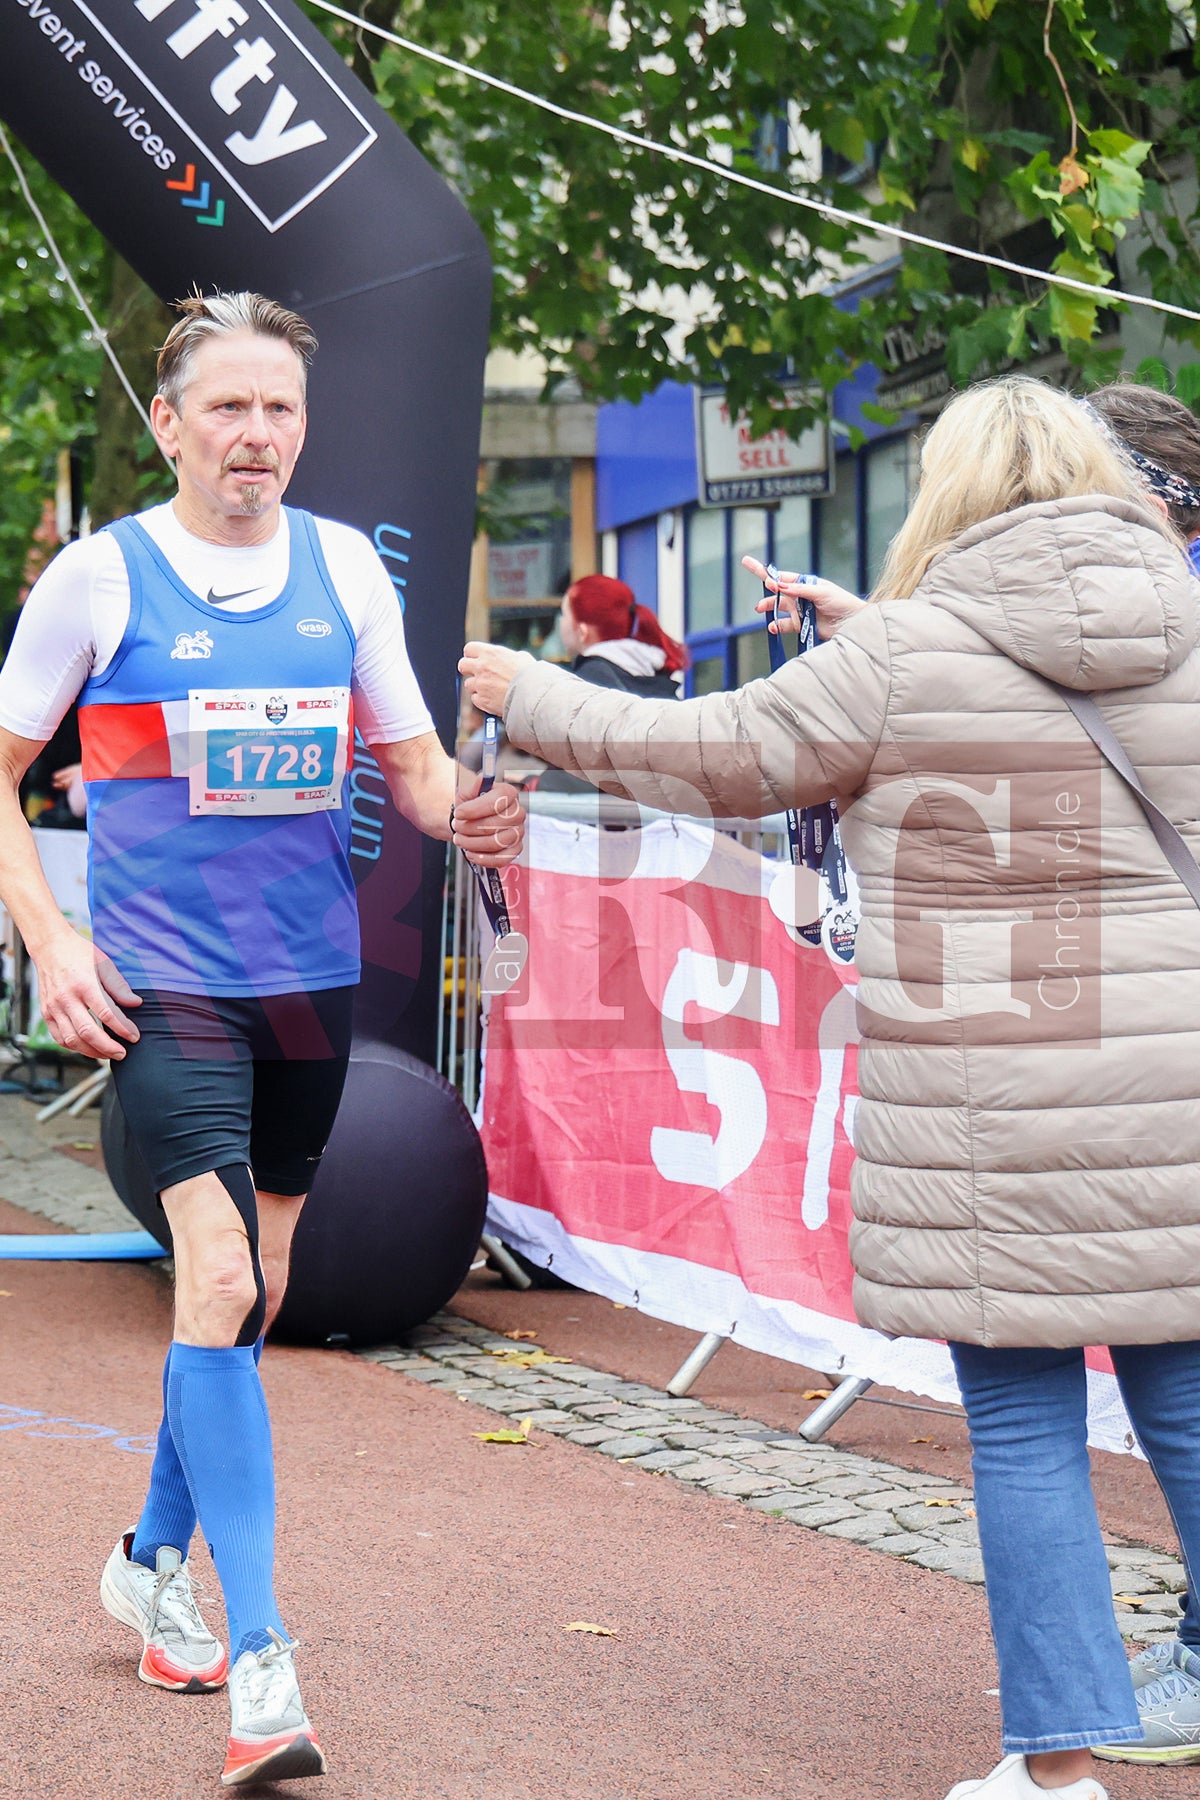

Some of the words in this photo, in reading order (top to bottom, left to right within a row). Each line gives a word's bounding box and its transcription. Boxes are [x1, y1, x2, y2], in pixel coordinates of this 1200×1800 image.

[78, 60, 177, 171] services
[738, 448, 791, 471] SELL
[299, 623, 329, 635] wasp
[215, 701, 247, 711] SPAR
[305, 700, 333, 709] SPAR
[226, 744, 322, 782] 1728
[215, 793, 247, 802] SPAR
[304, 789, 327, 800] SPAR
[814, 819, 822, 846] SPAR
